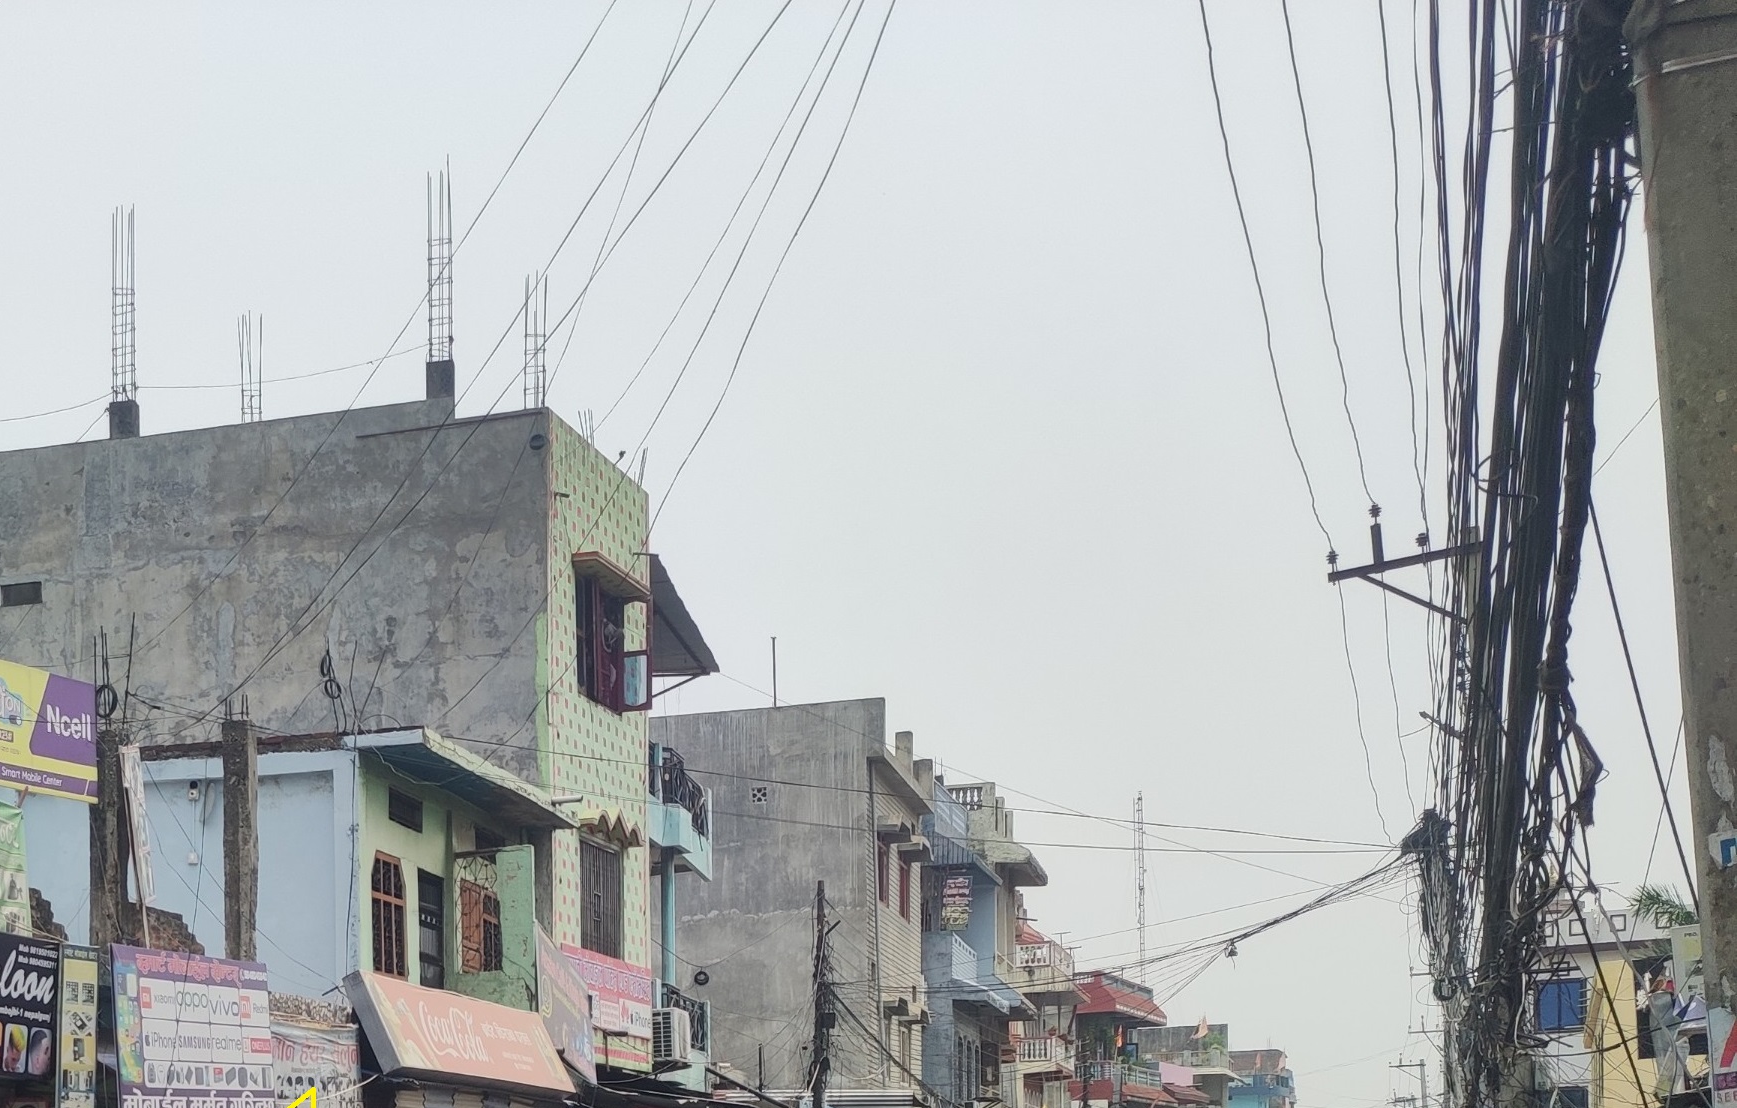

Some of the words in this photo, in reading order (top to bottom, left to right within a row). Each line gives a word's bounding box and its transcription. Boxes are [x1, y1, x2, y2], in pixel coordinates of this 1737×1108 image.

[46, 704, 92, 741] Ncell
[2, 766, 21, 779] Smart
[22, 770, 42, 783] Mobile
[42, 774, 63, 787] Center
[176, 990, 208, 1012] oppo
[210, 996, 240, 1016] vivo
[252, 1003, 268, 1014] Redmi
[151, 1031, 176, 1049] iPhone
[179, 1034, 210, 1050] SAMSUNG
[212, 1036, 242, 1052] realme
